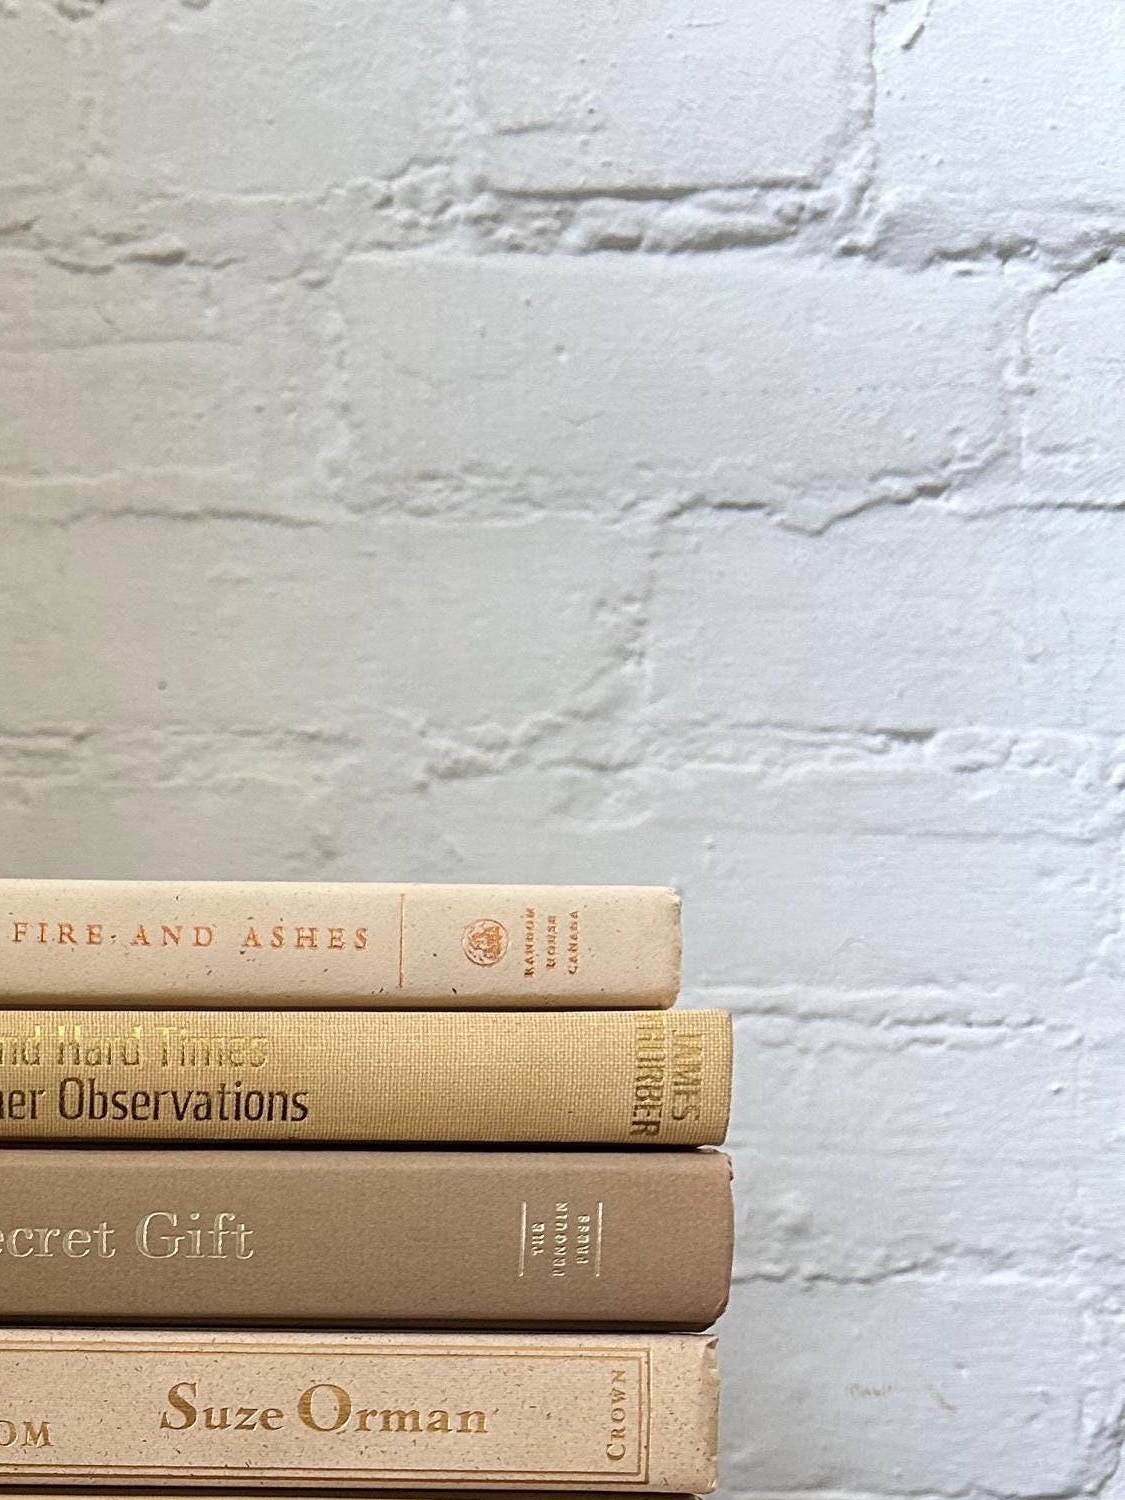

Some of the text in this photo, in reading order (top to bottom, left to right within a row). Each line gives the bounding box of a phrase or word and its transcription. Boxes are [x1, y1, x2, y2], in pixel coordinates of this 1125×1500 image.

[9, 922, 370, 952] FIRE AND ASHES
[57, 1026, 141, 1067] Hard
[153, 1026, 268, 1068] Times
[59, 1077, 309, 1121] Observations
[135, 1211, 254, 1261] Gift
[160, 1381, 489, 1434] Suze Orman
